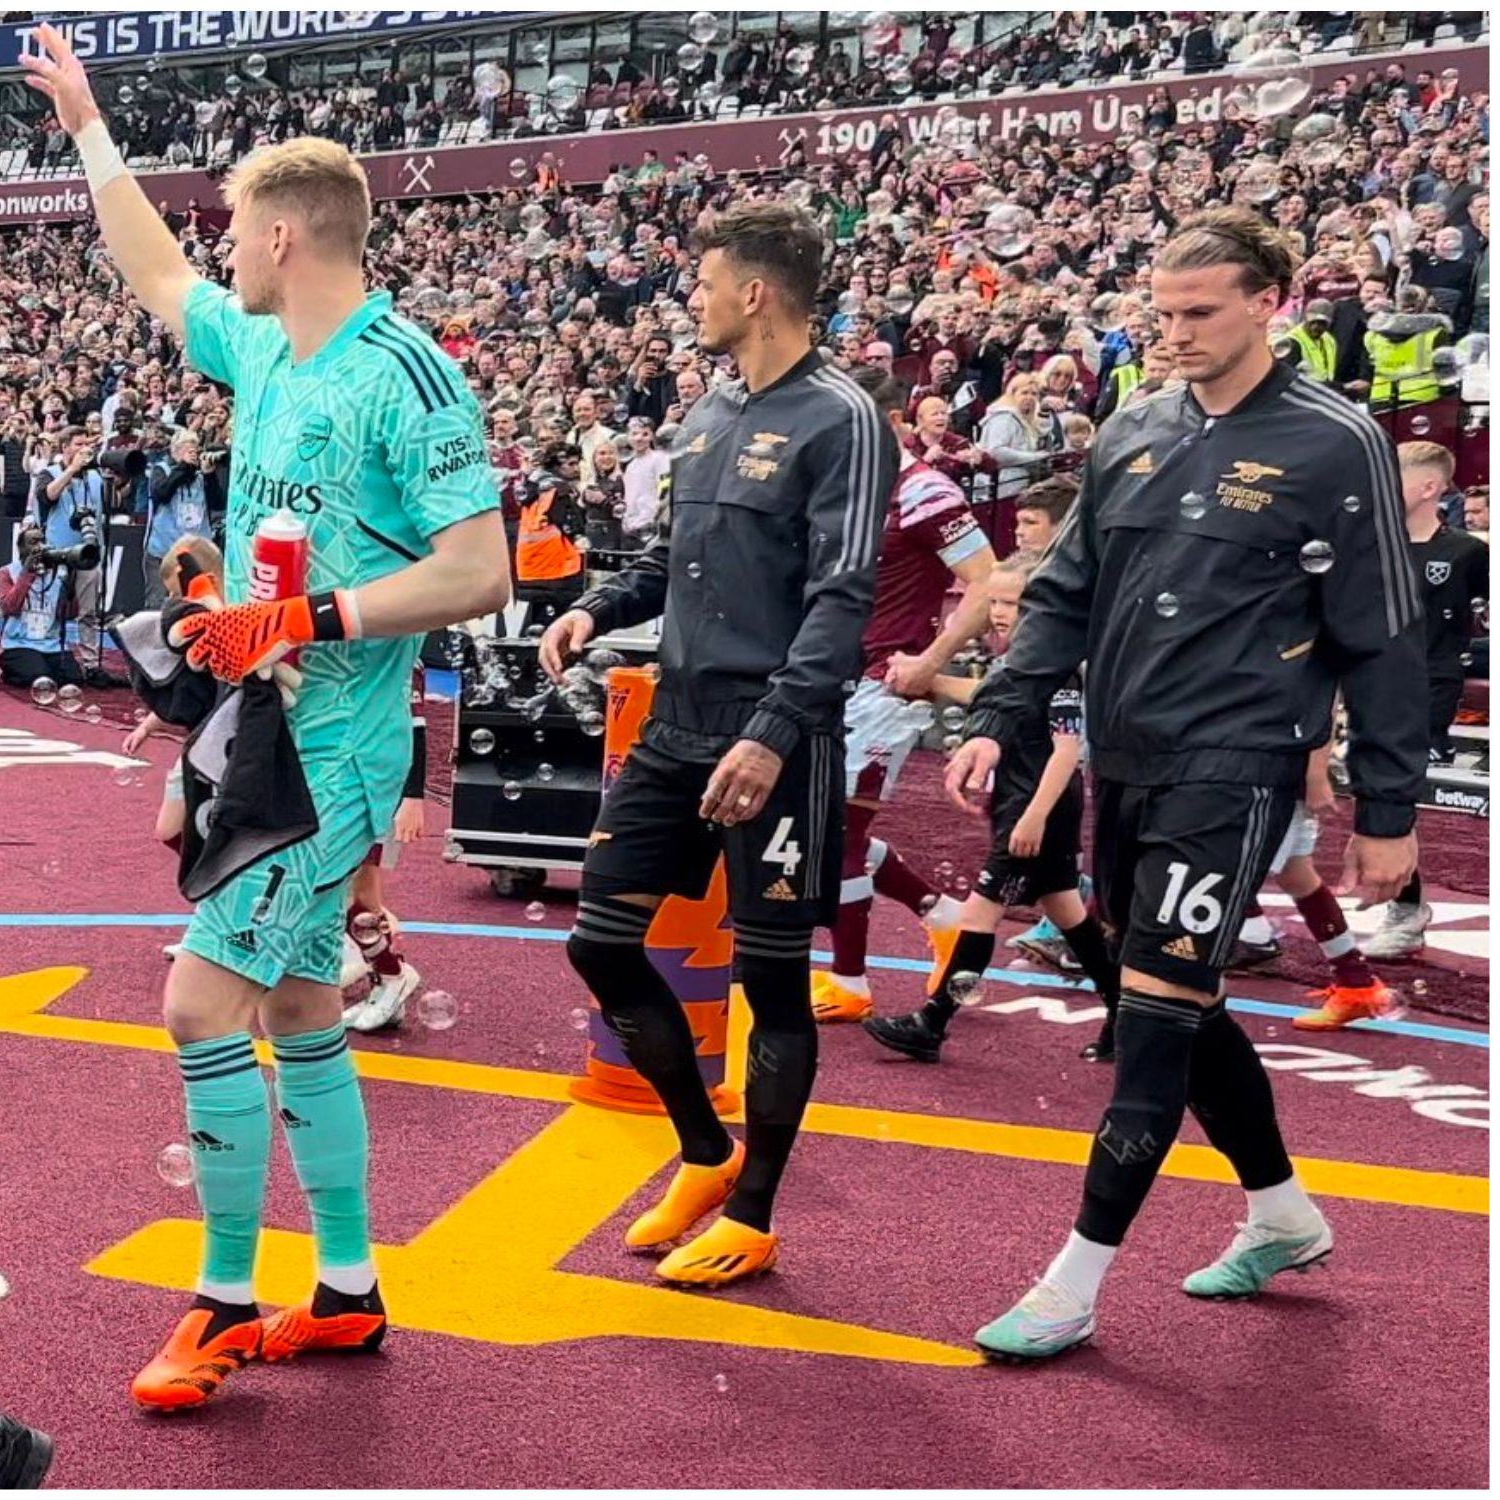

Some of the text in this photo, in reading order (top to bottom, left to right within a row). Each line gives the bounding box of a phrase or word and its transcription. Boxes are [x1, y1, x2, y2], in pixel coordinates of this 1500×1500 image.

[106, 17, 140, 54] IS
[148, 11, 223, 50] THE
[1091, 88, 1223, 134] Uned
[236, 463, 322, 514] irates
[1216, 482, 1274, 504] Emirates
[762, 817, 802, 875] 4
[251, 863, 286, 926] 1
[1156, 861, 1225, 934] 16
